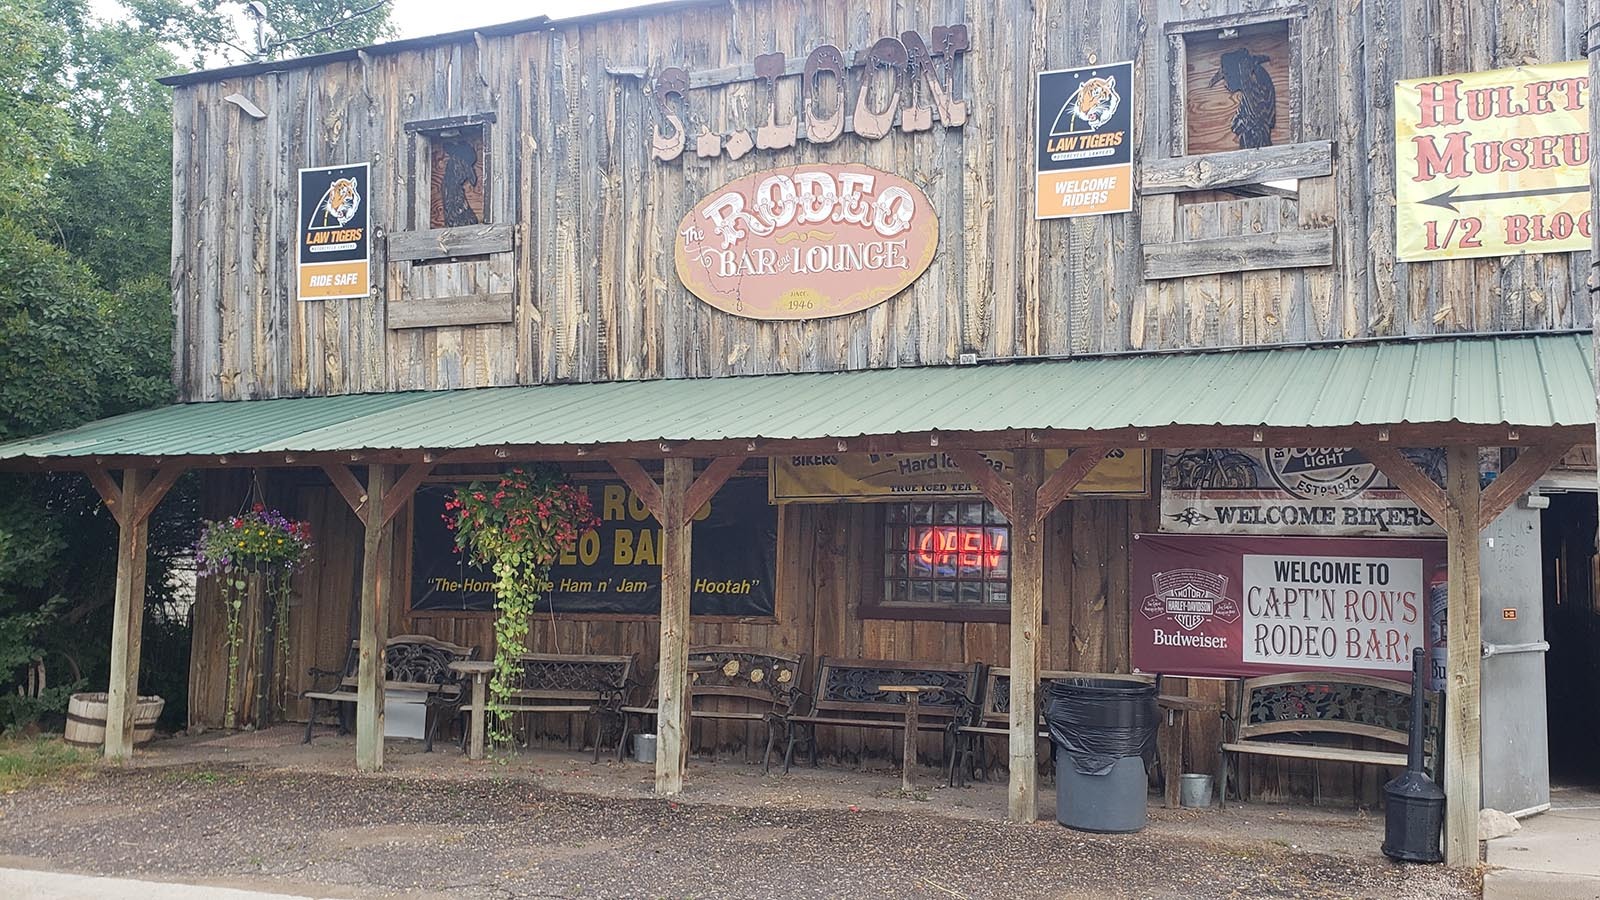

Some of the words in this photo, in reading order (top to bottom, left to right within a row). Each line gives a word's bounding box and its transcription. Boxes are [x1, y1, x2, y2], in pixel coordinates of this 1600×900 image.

[1415, 77, 1590, 129] HULET
[1047, 137, 1078, 153] LAW
[1080, 131, 1123, 149] TIGERS
[1412, 131, 1590, 182] MUSEU
[1055, 176, 1117, 194] WELCOME
[1062, 191, 1109, 207] RIDERS
[701, 171, 915, 249] RODEO
[306, 231, 330, 244] LAW
[331, 228, 362, 242] TIGERS
[680, 225, 705, 246] The
[1424, 217, 1483, 250] 1/2
[1504, 210, 1592, 245] BLOC
[716, 247, 778, 277] BAR
[791, 240, 909, 274] LOUNGE
[309, 275, 333, 287] RIDE
[334, 273, 358, 286] SAFE
[788, 299, 813, 311] 1946
[899, 453, 938, 475] Hard
[1304, 452, 1345, 468] LIGHT
[890, 484, 918, 493] TRUE
[921, 483, 947, 492] ICED
[951, 482, 972, 491] TEA
[1333, 475, 1360, 495] 1978
[1214, 505, 1335, 526] WELCOME
[1342, 506, 1435, 532] BIKERS
[920, 529, 1003, 568] OPEN
[1274, 561, 1362, 585] WELCOME
[1366, 563, 1389, 586] TO
[559, 578, 593, 592] Ham
[616, 578, 647, 592] Jam
[1177, 587, 1202, 598] MOTOR
[1168, 600, 1211, 612] HARLEY-DAVIDSON
[1247, 586, 1336, 620] CAPT'N
[1344, 589, 1417, 624] RON'S
[1178, 615, 1201, 628] CYCLES
[1254, 623, 1337, 658] RODEO
[1345, 627, 1412, 664] BAR!
